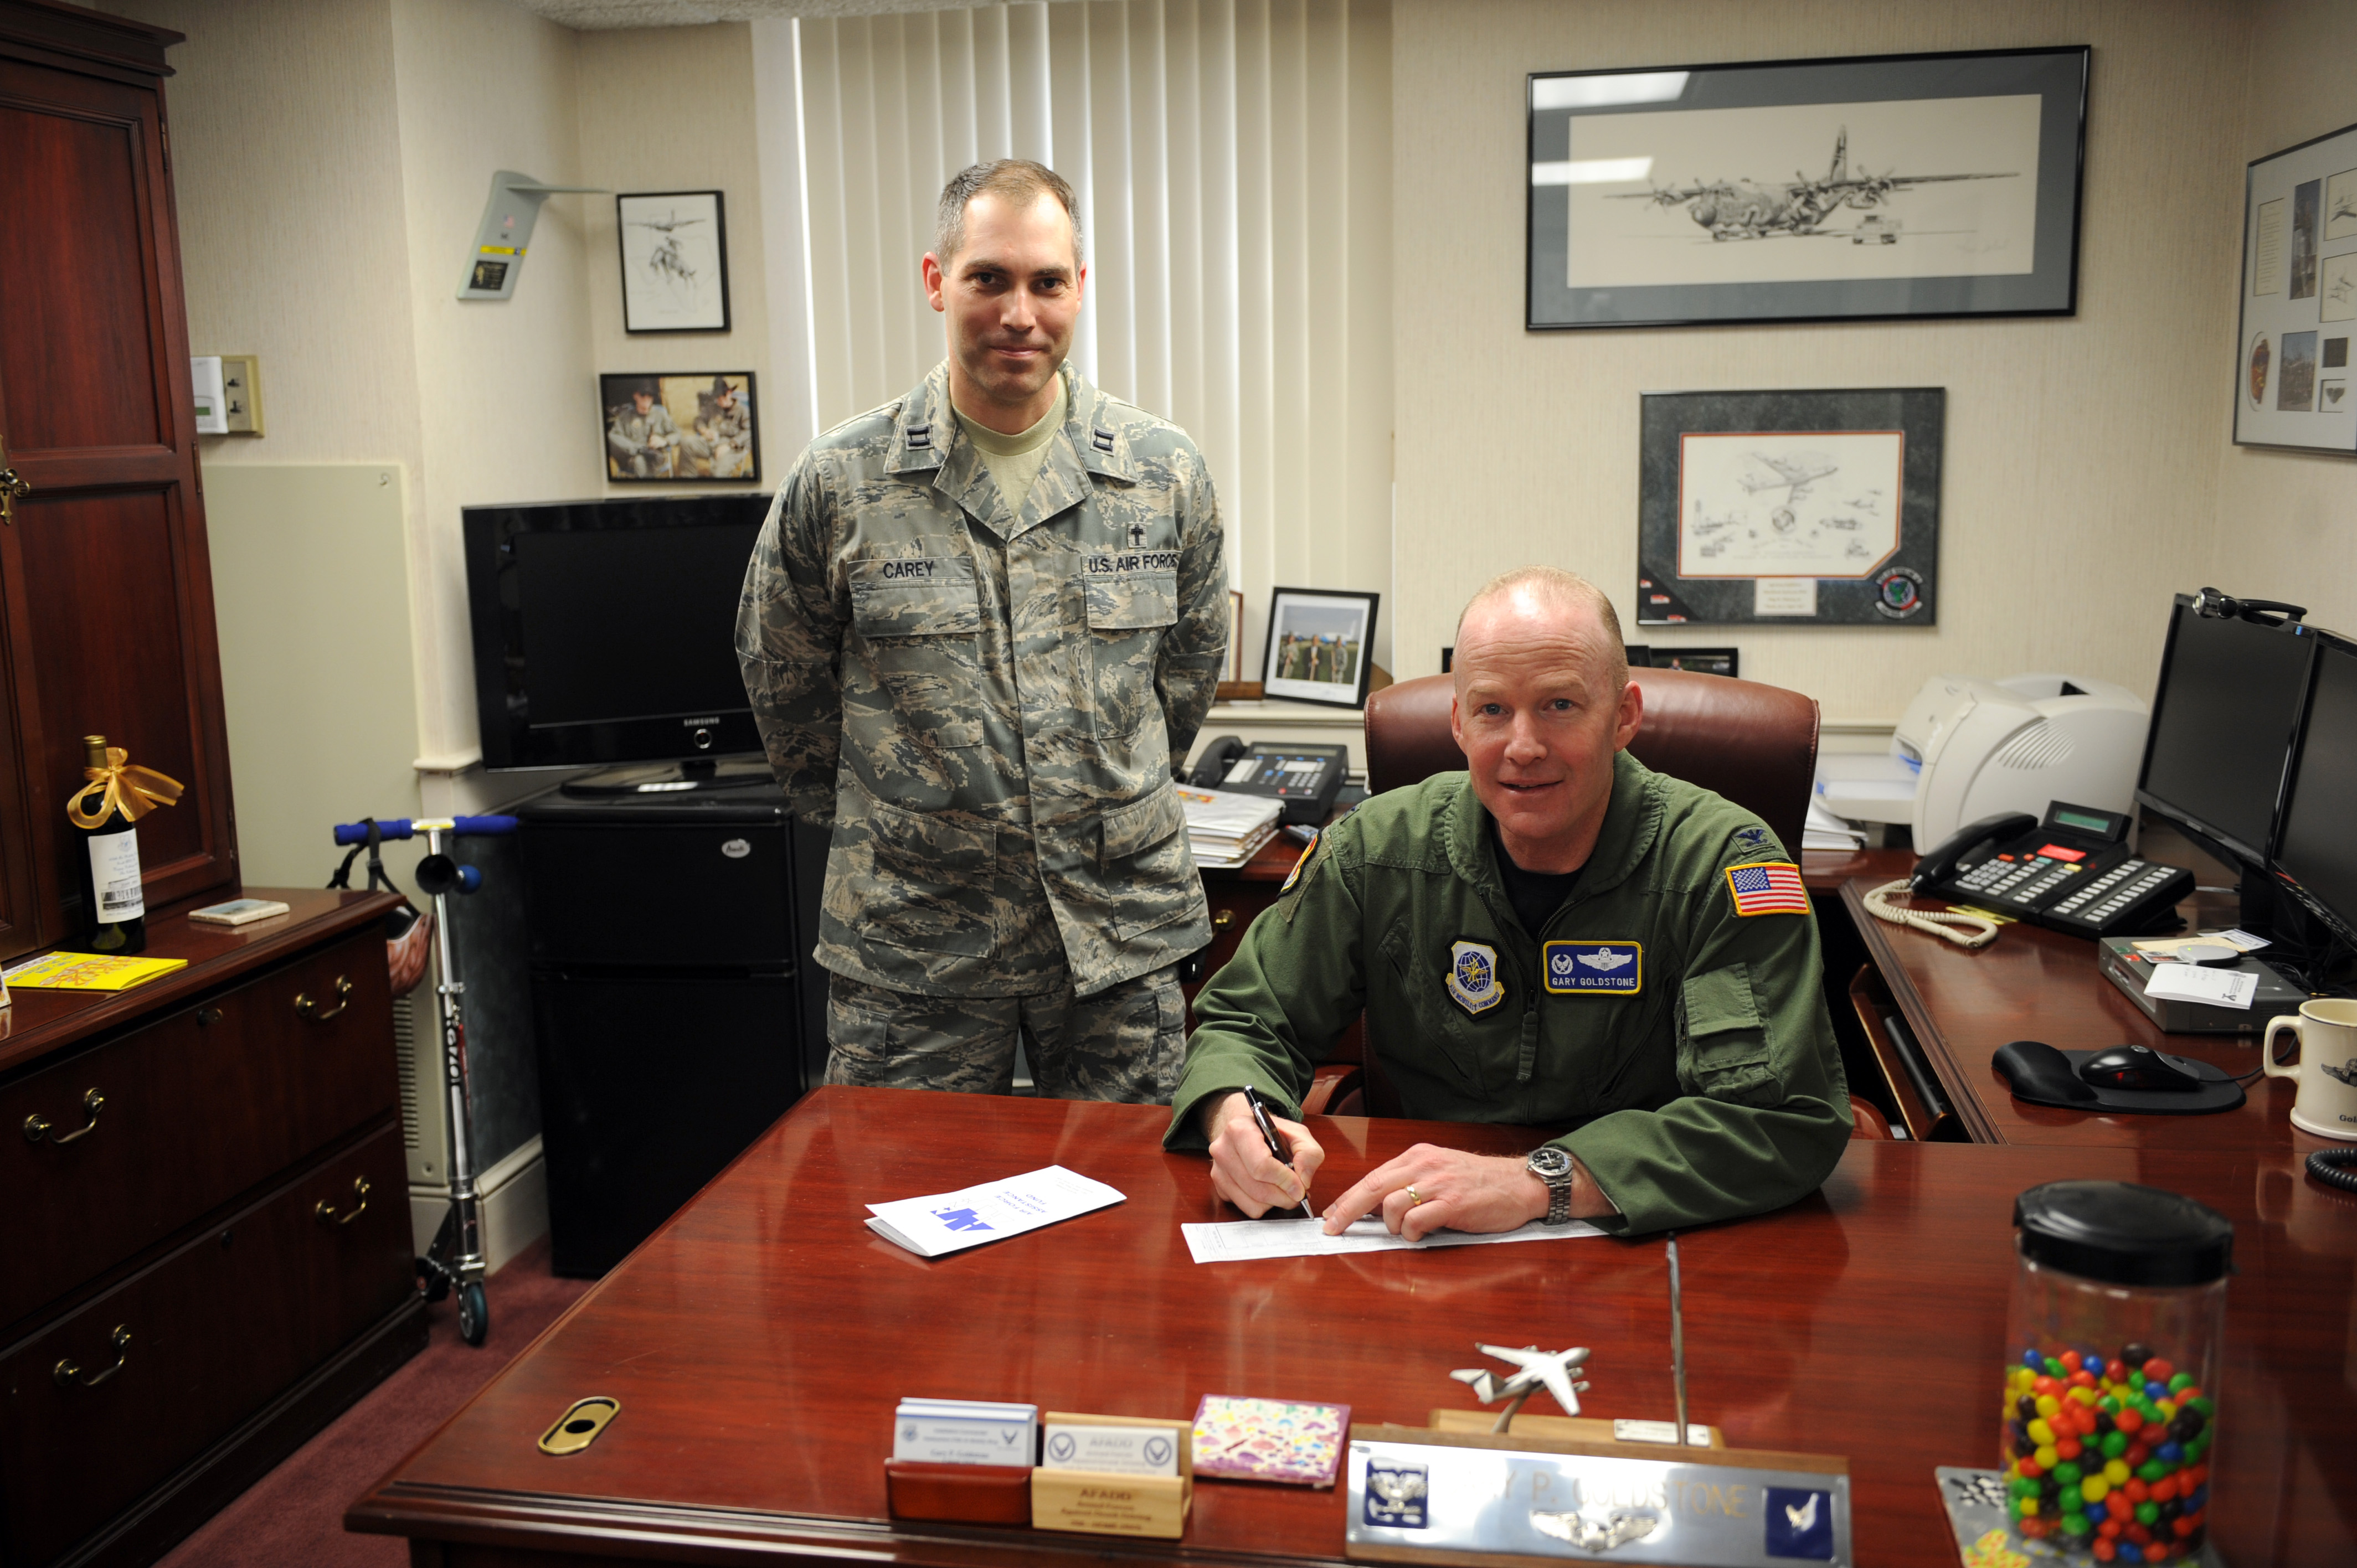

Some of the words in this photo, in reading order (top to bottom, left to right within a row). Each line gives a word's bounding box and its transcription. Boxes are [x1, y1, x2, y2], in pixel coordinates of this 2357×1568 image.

[883, 561, 934, 579] CAREY
[1089, 558, 1113, 572] U.S.
[1116, 556, 1140, 571] AIR
[1143, 553, 1177, 569] FORCE
[683, 716, 720, 727] SAMSUNG
[1552, 977, 1576, 986] GARY
[1580, 978, 1635, 987] GOLDSTONE
[1449, 984, 1457, 996] AIR
[1456, 994, 1477, 1011] MOBILITY
[1479, 992, 1500, 1008] COMMAND
[994, 1195, 1020, 1209] FORCE
[1002, 1190, 1048, 1214] ASSISTANCE
[1026, 1194, 1047, 1205] FUND
